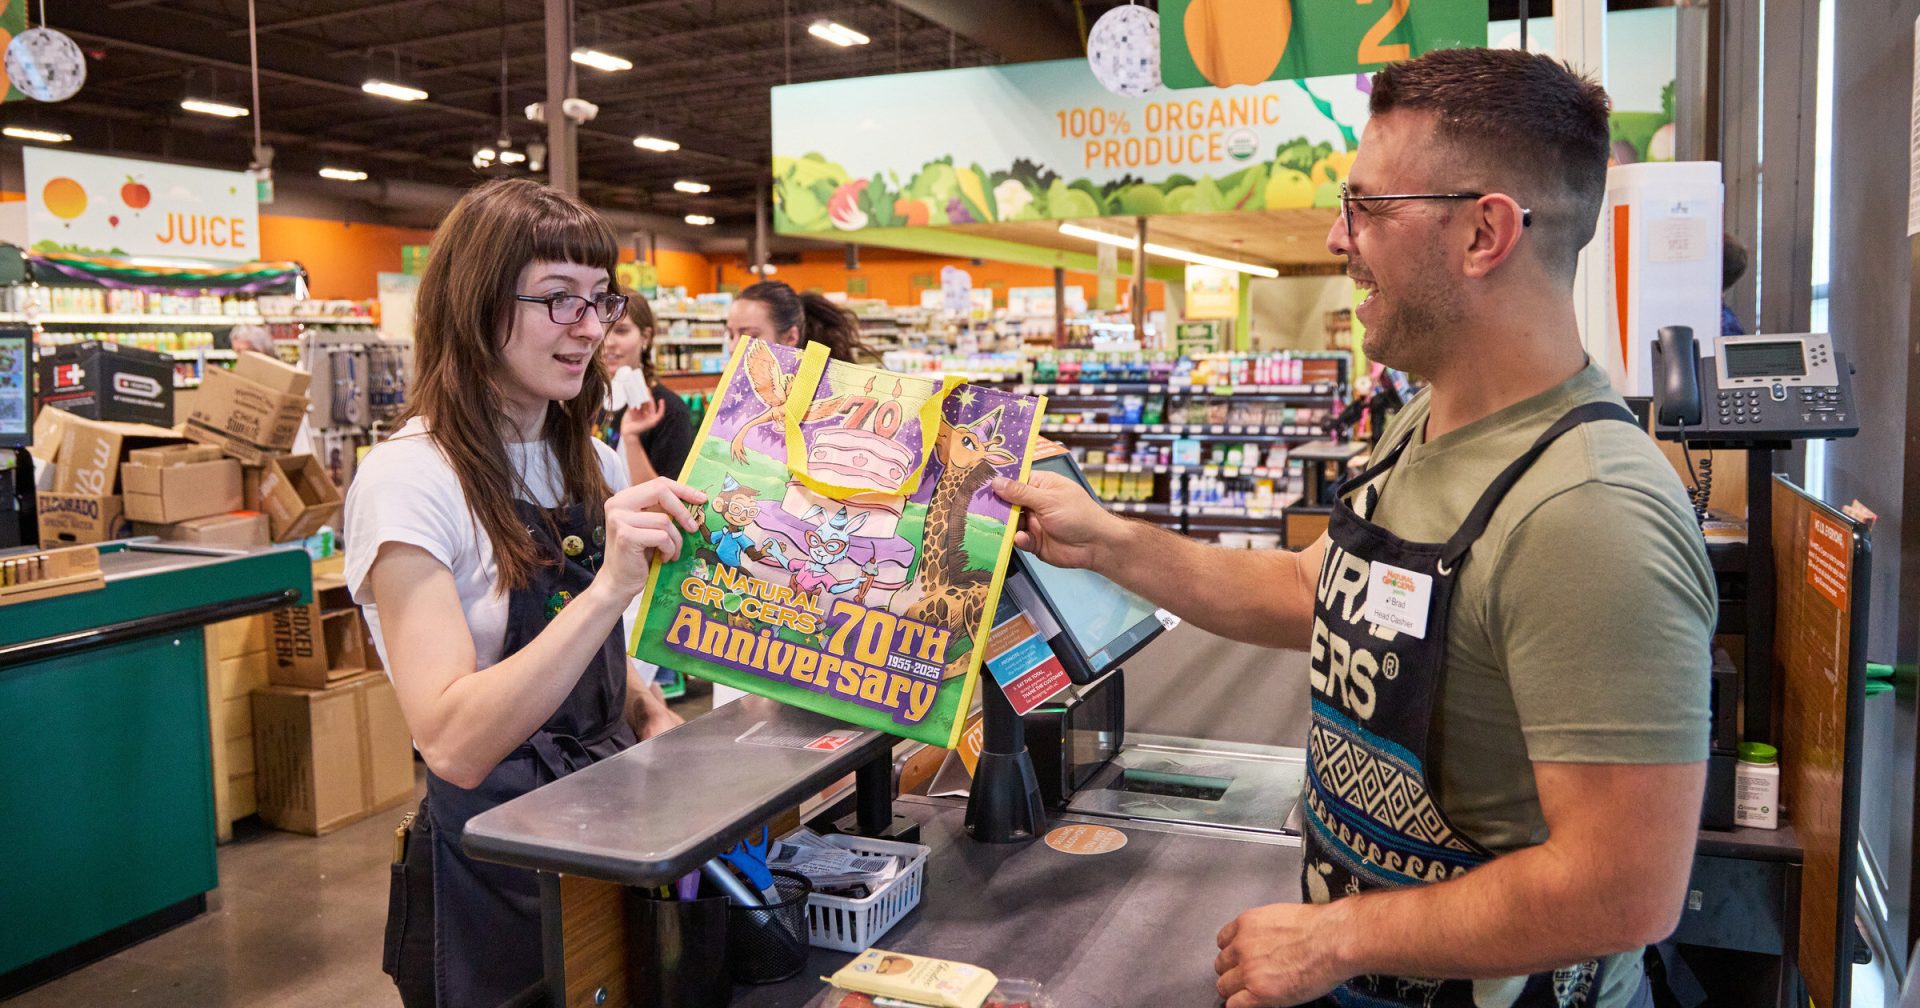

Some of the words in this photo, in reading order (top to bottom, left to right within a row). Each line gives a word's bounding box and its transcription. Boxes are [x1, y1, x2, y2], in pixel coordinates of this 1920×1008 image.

[1357, 0, 1410, 65] 2
[1056, 107, 1131, 138] 100%
[1144, 95, 1280, 133] ORGANIC
[1085, 132, 1225, 169] PRODUCE
[156, 211, 246, 248] JUICE
[839, 394, 903, 440] 70
[680, 576, 818, 635] GROCERS
[711, 562, 825, 617] NATURAL
[1391, 597, 1406, 609] Brad
[827, 600, 951, 669] 70TH
[1374, 609, 1390, 621] Head
[1390, 614, 1414, 629] Cashier
[665, 605, 937, 722] Anniversary
[886, 654, 941, 680] 1955-2025
